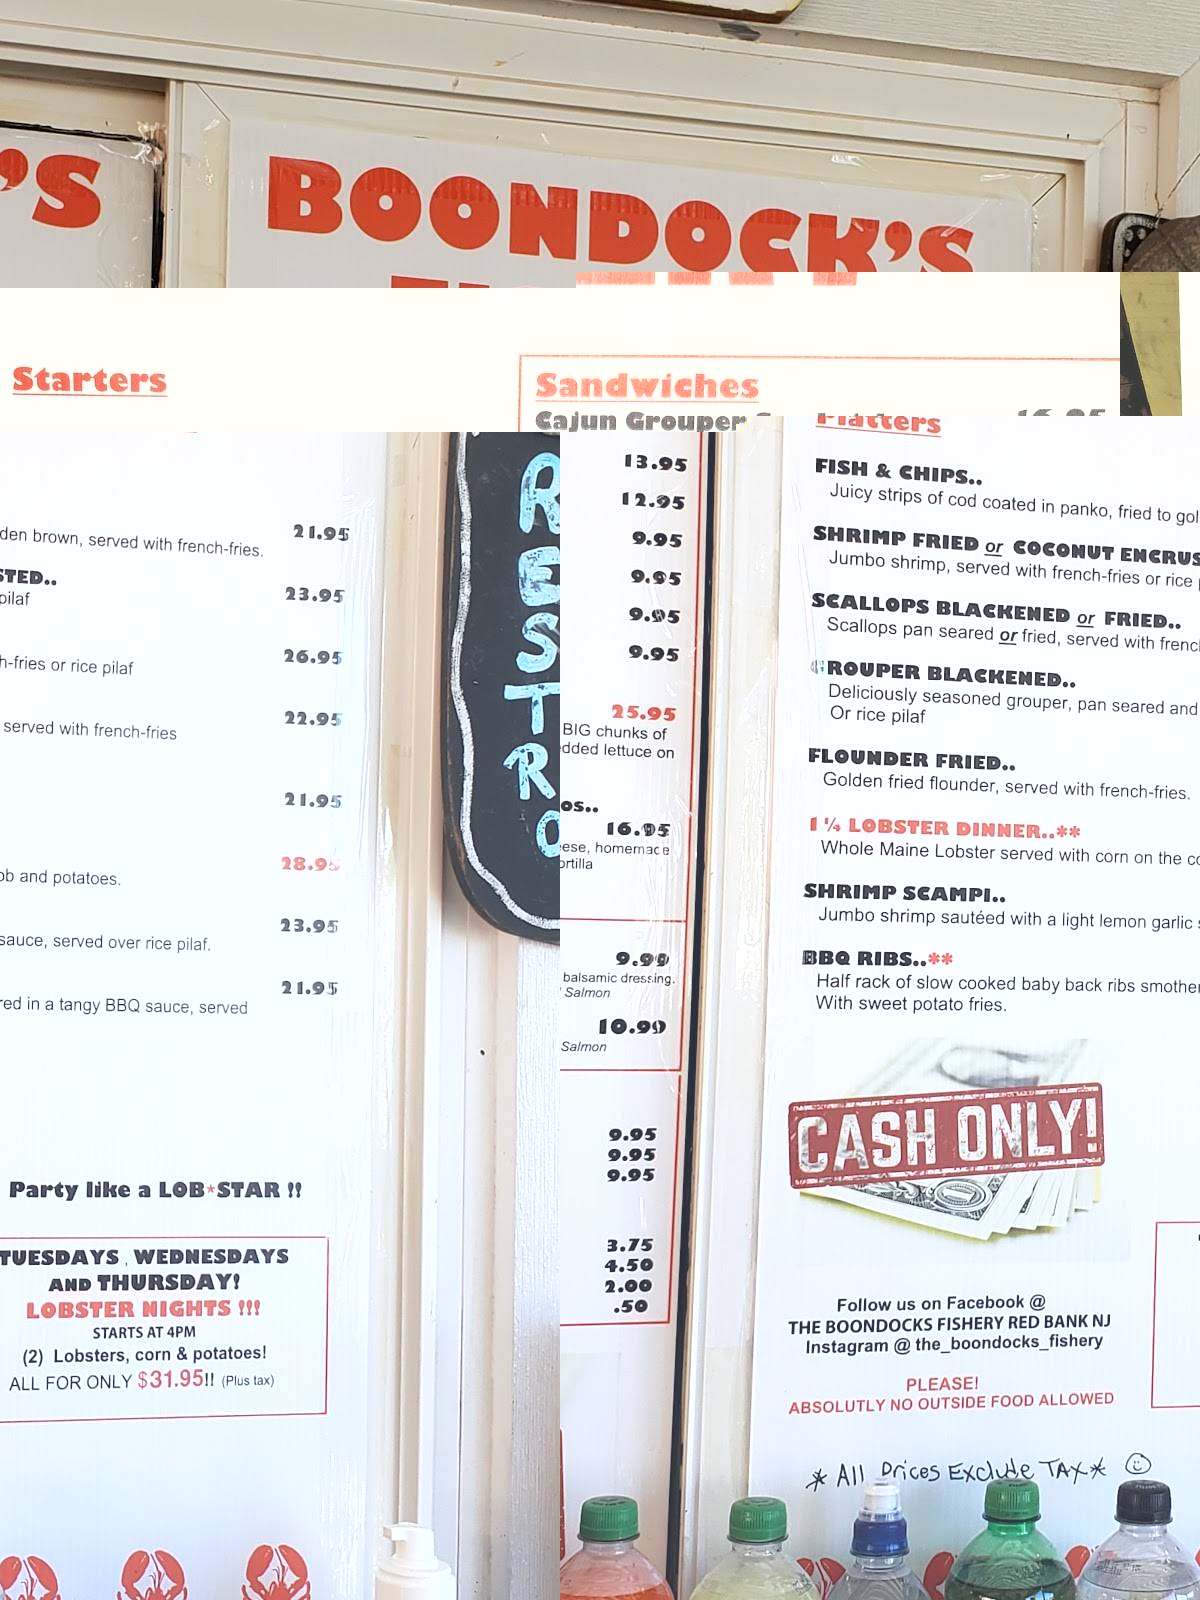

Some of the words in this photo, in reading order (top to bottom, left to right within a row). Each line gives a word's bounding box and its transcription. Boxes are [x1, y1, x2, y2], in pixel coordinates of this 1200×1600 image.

[267, 156, 974, 272] BOONDOCK'S
[13, 366, 167, 393] Starters
[536, 372, 758, 398] Sandwiches
[536, 411, 617, 432] Cajun
[624, 454, 687, 472] 13.95
[816, 458, 868, 476] FISH
[622, 492, 685, 510] 12.95
[830, 483, 872, 503] Juicy
[878, 488, 922, 506] strips
[948, 494, 976, 507] cod
[983, 497, 1035, 512] coated
[1061, 502, 1112, 520] panko,
[1119, 504, 1151, 520] fried
[33, 528, 82, 547] brown,
[178, 538, 263, 557] french-fries.
[293, 525, 350, 543] 21.95
[632, 531, 683, 548] 9.95
[813, 526, 906, 546] SHRIMP
[913, 533, 979, 551] FRIED
[1013, 540, 1114, 560] COCONUT
[829, 550, 885, 567] Jumbo
[891, 555, 950, 575] shrimp,
[957, 562, 1009, 576] served
[1052, 565, 1140, 584] french-fries
[631, 570, 681, 586] 9.95
[285, 586, 345, 604] 23.95
[629, 607, 680, 623] 9.95
[811, 593, 929, 614] SCALLOPS
[936, 601, 1070, 622] BLACKENED
[827, 617, 897, 637] Scallops
[939, 627, 993, 640] seared
[1067, 632, 1118, 647] served
[284, 649, 342, 666] 26.95
[629, 645, 679, 662] 9.95
[103, 661, 134, 677] pilaf
[829, 683, 917, 705] Deliciously
[923, 692, 1000, 706] seasoned
[1007, 696, 1071, 712] grouper,
[284, 710, 342, 727] 22.95
[612, 704, 676, 721] 25.95
[892, 704, 926, 726] pilaf
[809, 748, 928, 767] FLOUNDER
[824, 772, 882, 788] Golden
[889, 774, 923, 789] fried
[929, 776, 998, 794] flounder,
[1100, 783, 1190, 800] french-fries.
[284, 792, 342, 809] 21.95
[607, 822, 670, 837] 16.95
[849, 818, 949, 835] LOBSTER
[821, 840, 873, 855] Whole
[880, 842, 929, 857] Maine
[936, 844, 995, 859] Lobster
[1096, 852, 1128, 863] corn
[53, 872, 120, 887] potatoes.
[803, 883, 897, 900] SHRIMP
[280, 918, 339, 934] 23.95
[881, 908, 935, 927] shrimp
[941, 910, 1004, 925] sautéed
[1063, 912, 1094, 930] light
[1100, 914, 1146, 928] lemon
[1152, 915, 1192, 932] garlic
[0, 936, 47, 949] sauce,
[109, 939, 141, 949] over
[178, 937, 210, 953] pilaf.
[616, 951, 669, 966] 9.99
[802, 950, 850, 965] BBQ
[563, 972, 617, 983] balsamic
[817, 973, 851, 988] Half
[856, 974, 890, 988] rack
[917, 975, 953, 989] slow
[959, 976, 1015, 990] cooked
[1022, 976, 1060, 994] baby
[1066, 978, 1102, 992] back
[1108, 978, 1135, 992] ribs
[281, 980, 339, 996] 21.95
[565, 987, 610, 998] Salmon
[59, 998, 100, 1015] tangy
[106, 998, 140, 1013] BBQ
[146, 1002, 193, 1015] sauce,
[816, 995, 852, 1010] With
[859, 997, 907, 1010] sweet
[913, 997, 963, 1014] potato
[969, 997, 1006, 1011] fries.
[599, 1018, 666, 1034] 10.99
[561, 1041, 606, 1052] Salmon
[609, 1128, 657, 1141] 9.95
[797, 1109, 937, 1173] CASH
[957, 1097, 1098, 1161] ONLY!
[608, 1148, 656, 1161] 9.95
[607, 1168, 655, 1181] 9.95
[10, 1181, 79, 1201] Party
[86, 1181, 130, 1198] like
[607, 1239, 653, 1252] 3.75
[0, 1249, 119, 1266] TUESDAYS
[133, 1249, 289, 1264] WEDNESDAYS
[605, 1259, 653, 1272] 4.50
[48, 1278, 91, 1292] AND
[97, 1273, 240, 1291] THURSDAY!
[605, 1279, 652, 1293] 2.00
[27, 1301, 135, 1319] LOBSTER
[143, 1300, 231, 1317] NIGHTS
[614, 1300, 648, 1313] .50
[837, 1298, 891, 1312] Follow
[947, 1295, 1024, 1310] Facebook
[93, 1327, 143, 1339] STARTS
[167, 1326, 195, 1338] 4PM
[788, 1320, 821, 1335] THE
[826, 1318, 932, 1334] BOONDOCKS
[938, 1316, 1004, 1331] FISHERY
[1009, 1315, 1039, 1329] RED
[1044, 1314, 1088, 1328] BANK
[1093, 1314, 1110, 1327] NJ
[806, 1340, 888, 1356] Instagram
[915, 1333, 1103, 1354] the_boondocks_fishery
[23, 1349, 43, 1367] (2)
[54, 1348, 129, 1364] Lobsters,
[135, 1350, 170, 1361] corn
[193, 1345, 266, 1364] potatoes!
[9, 1376, 40, 1391] ALL
[46, 1376, 81, 1390] FOR
[87, 1374, 132, 1389] ONLY
[137, 1368, 215, 1391] $31.95!!
[221, 1373, 250, 1388] (Plus
[253, 1373, 275, 1387] tax)
[907, 1376, 978, 1392] PLEASE!
[789, 1399, 885, 1414] ABSOLUTLY
[891, 1398, 913, 1411] NO
[918, 1396, 986, 1410] OUTSIDE
[991, 1395, 1034, 1408] FOOD
[1039, 1392, 1114, 1406] ALLOWED
[837, 1464, 864, 1487] All
